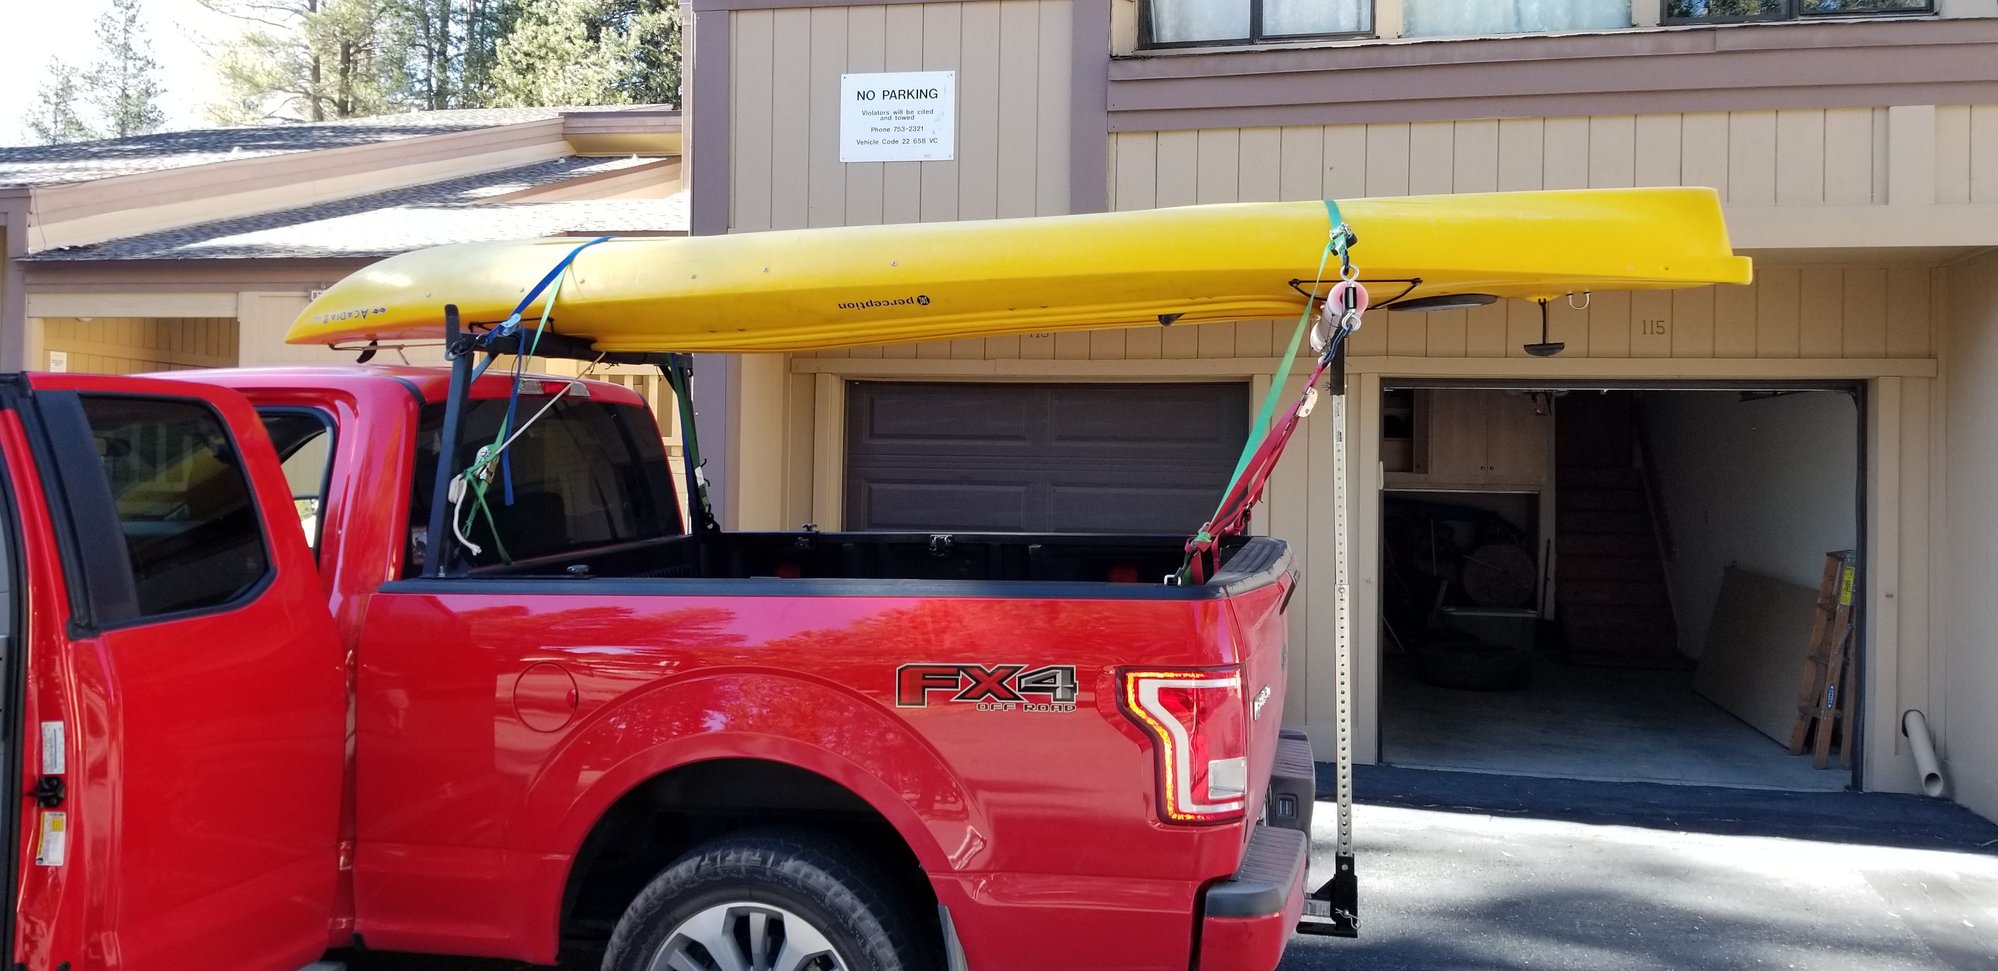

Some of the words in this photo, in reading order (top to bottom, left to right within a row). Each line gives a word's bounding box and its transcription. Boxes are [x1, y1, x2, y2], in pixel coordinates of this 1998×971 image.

[856, 90, 876, 101] NO
[882, 88, 938, 100] PARKING
[837, 296, 915, 310] perception
[1642, 319, 1666, 335] 115
[895, 662, 1079, 708] FX4
[976, 702, 1017, 712] OFF
[1023, 703, 1077, 713] ROAD
